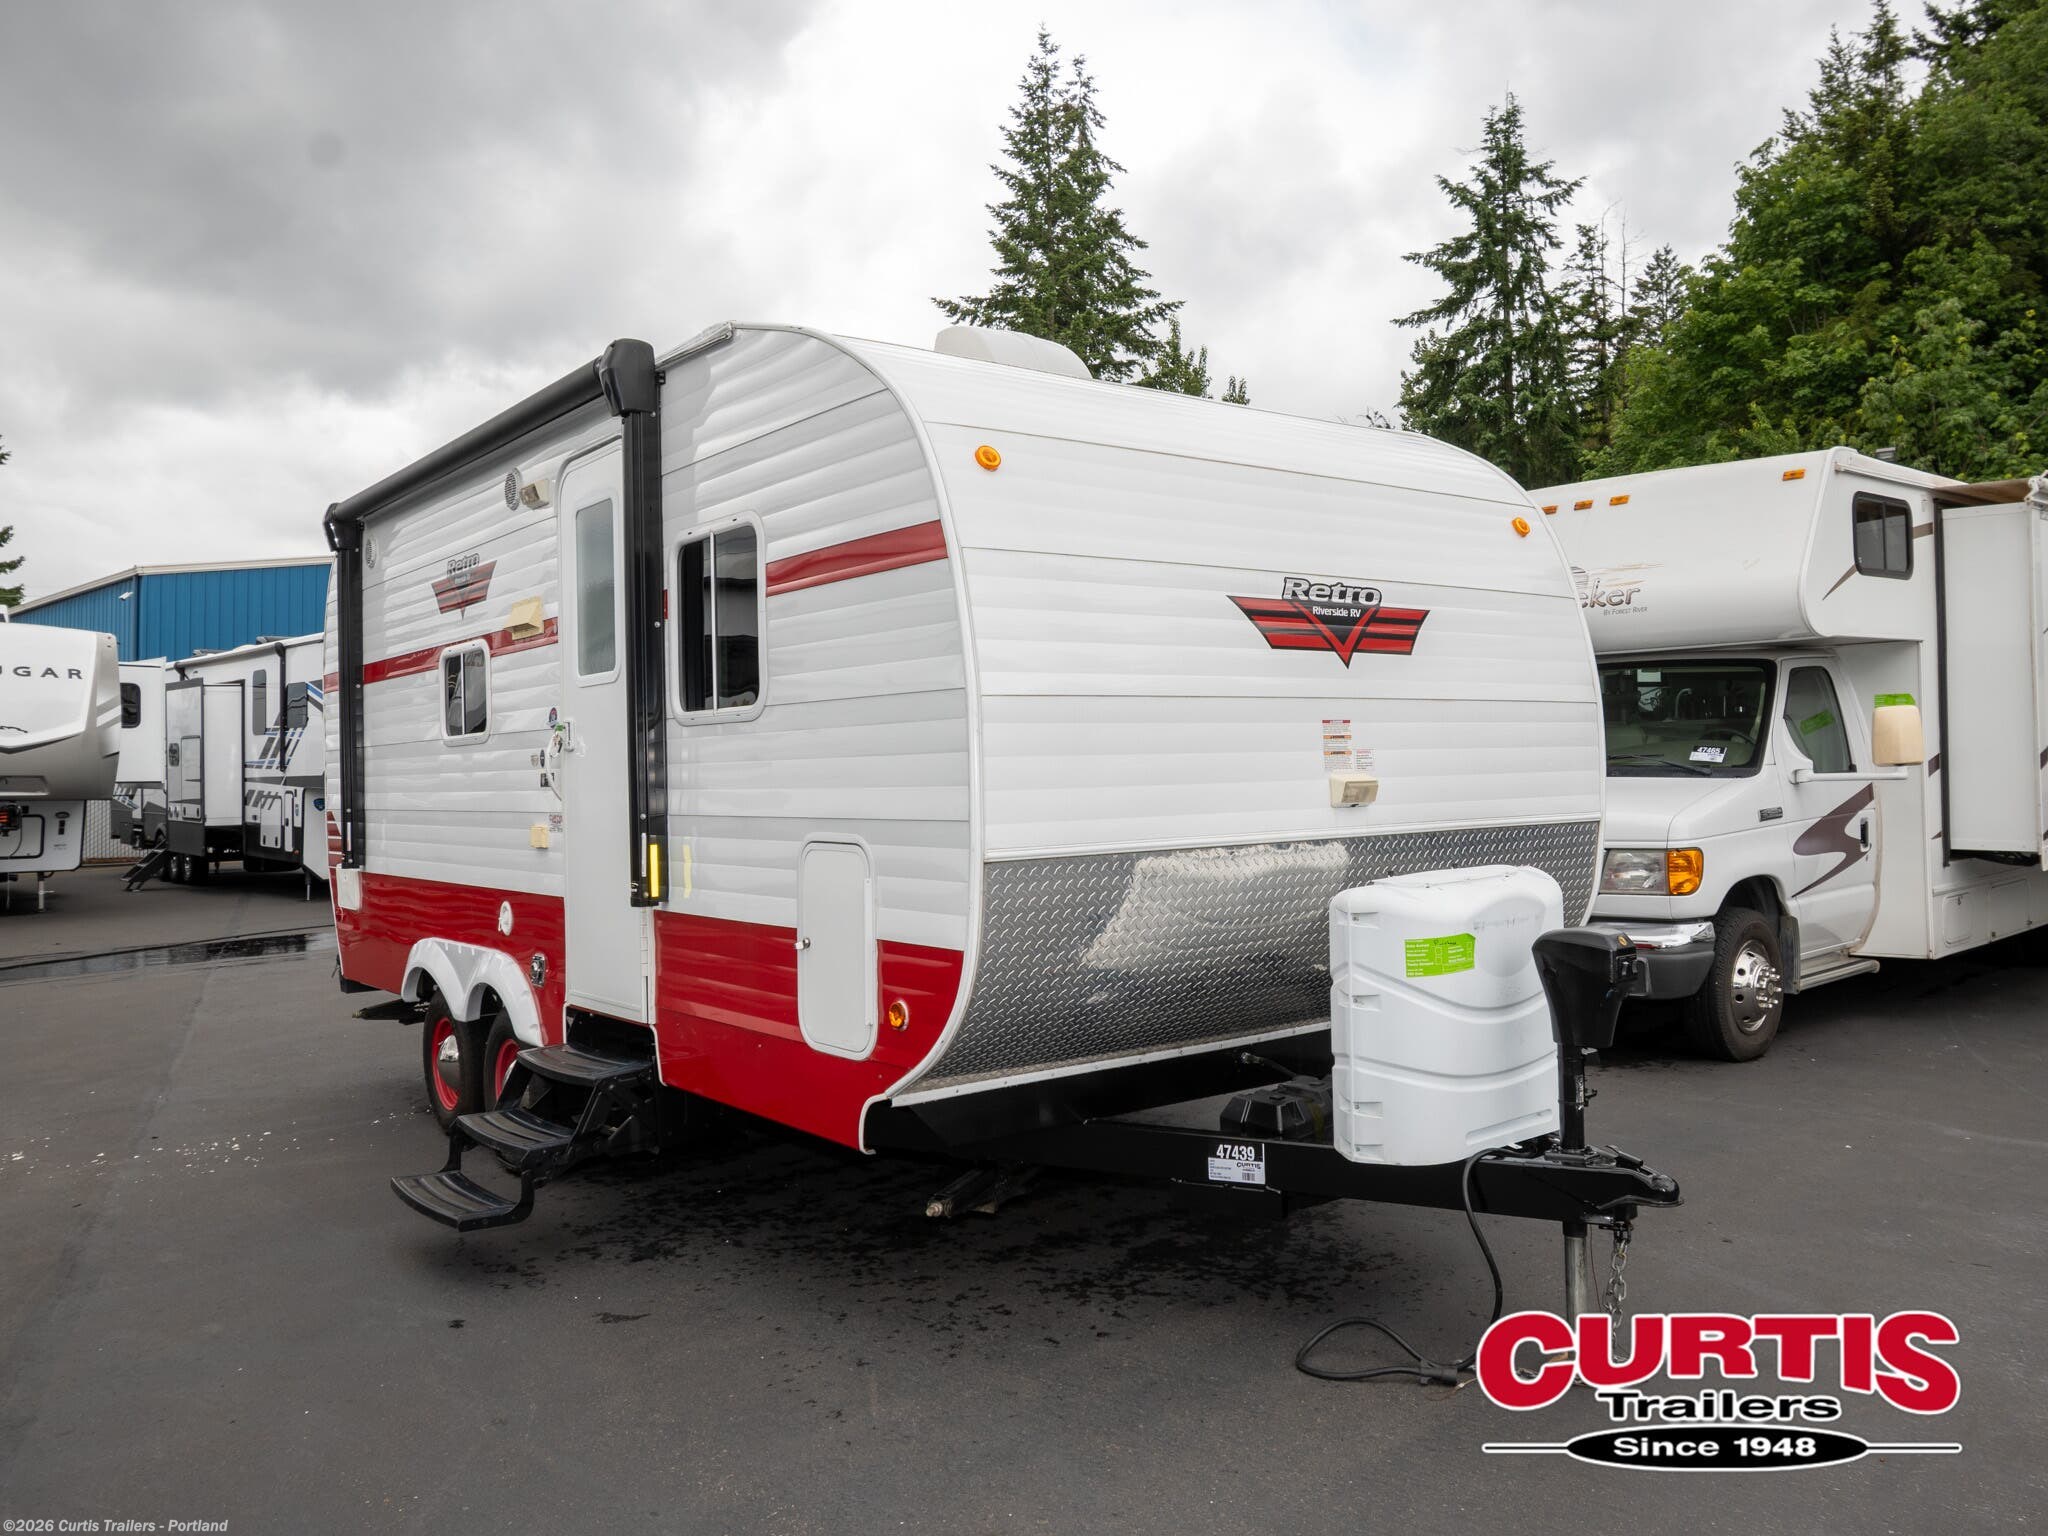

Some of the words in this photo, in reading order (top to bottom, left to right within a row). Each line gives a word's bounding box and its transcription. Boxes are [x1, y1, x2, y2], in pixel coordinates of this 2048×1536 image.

[1282, 577, 1382, 606] Retro
[1312, 605, 1349, 617] Riverside
[1350, 608, 1362, 618] RV
[0, 664, 83, 680] GAR
[1216, 1144, 1256, 1161] 47439
